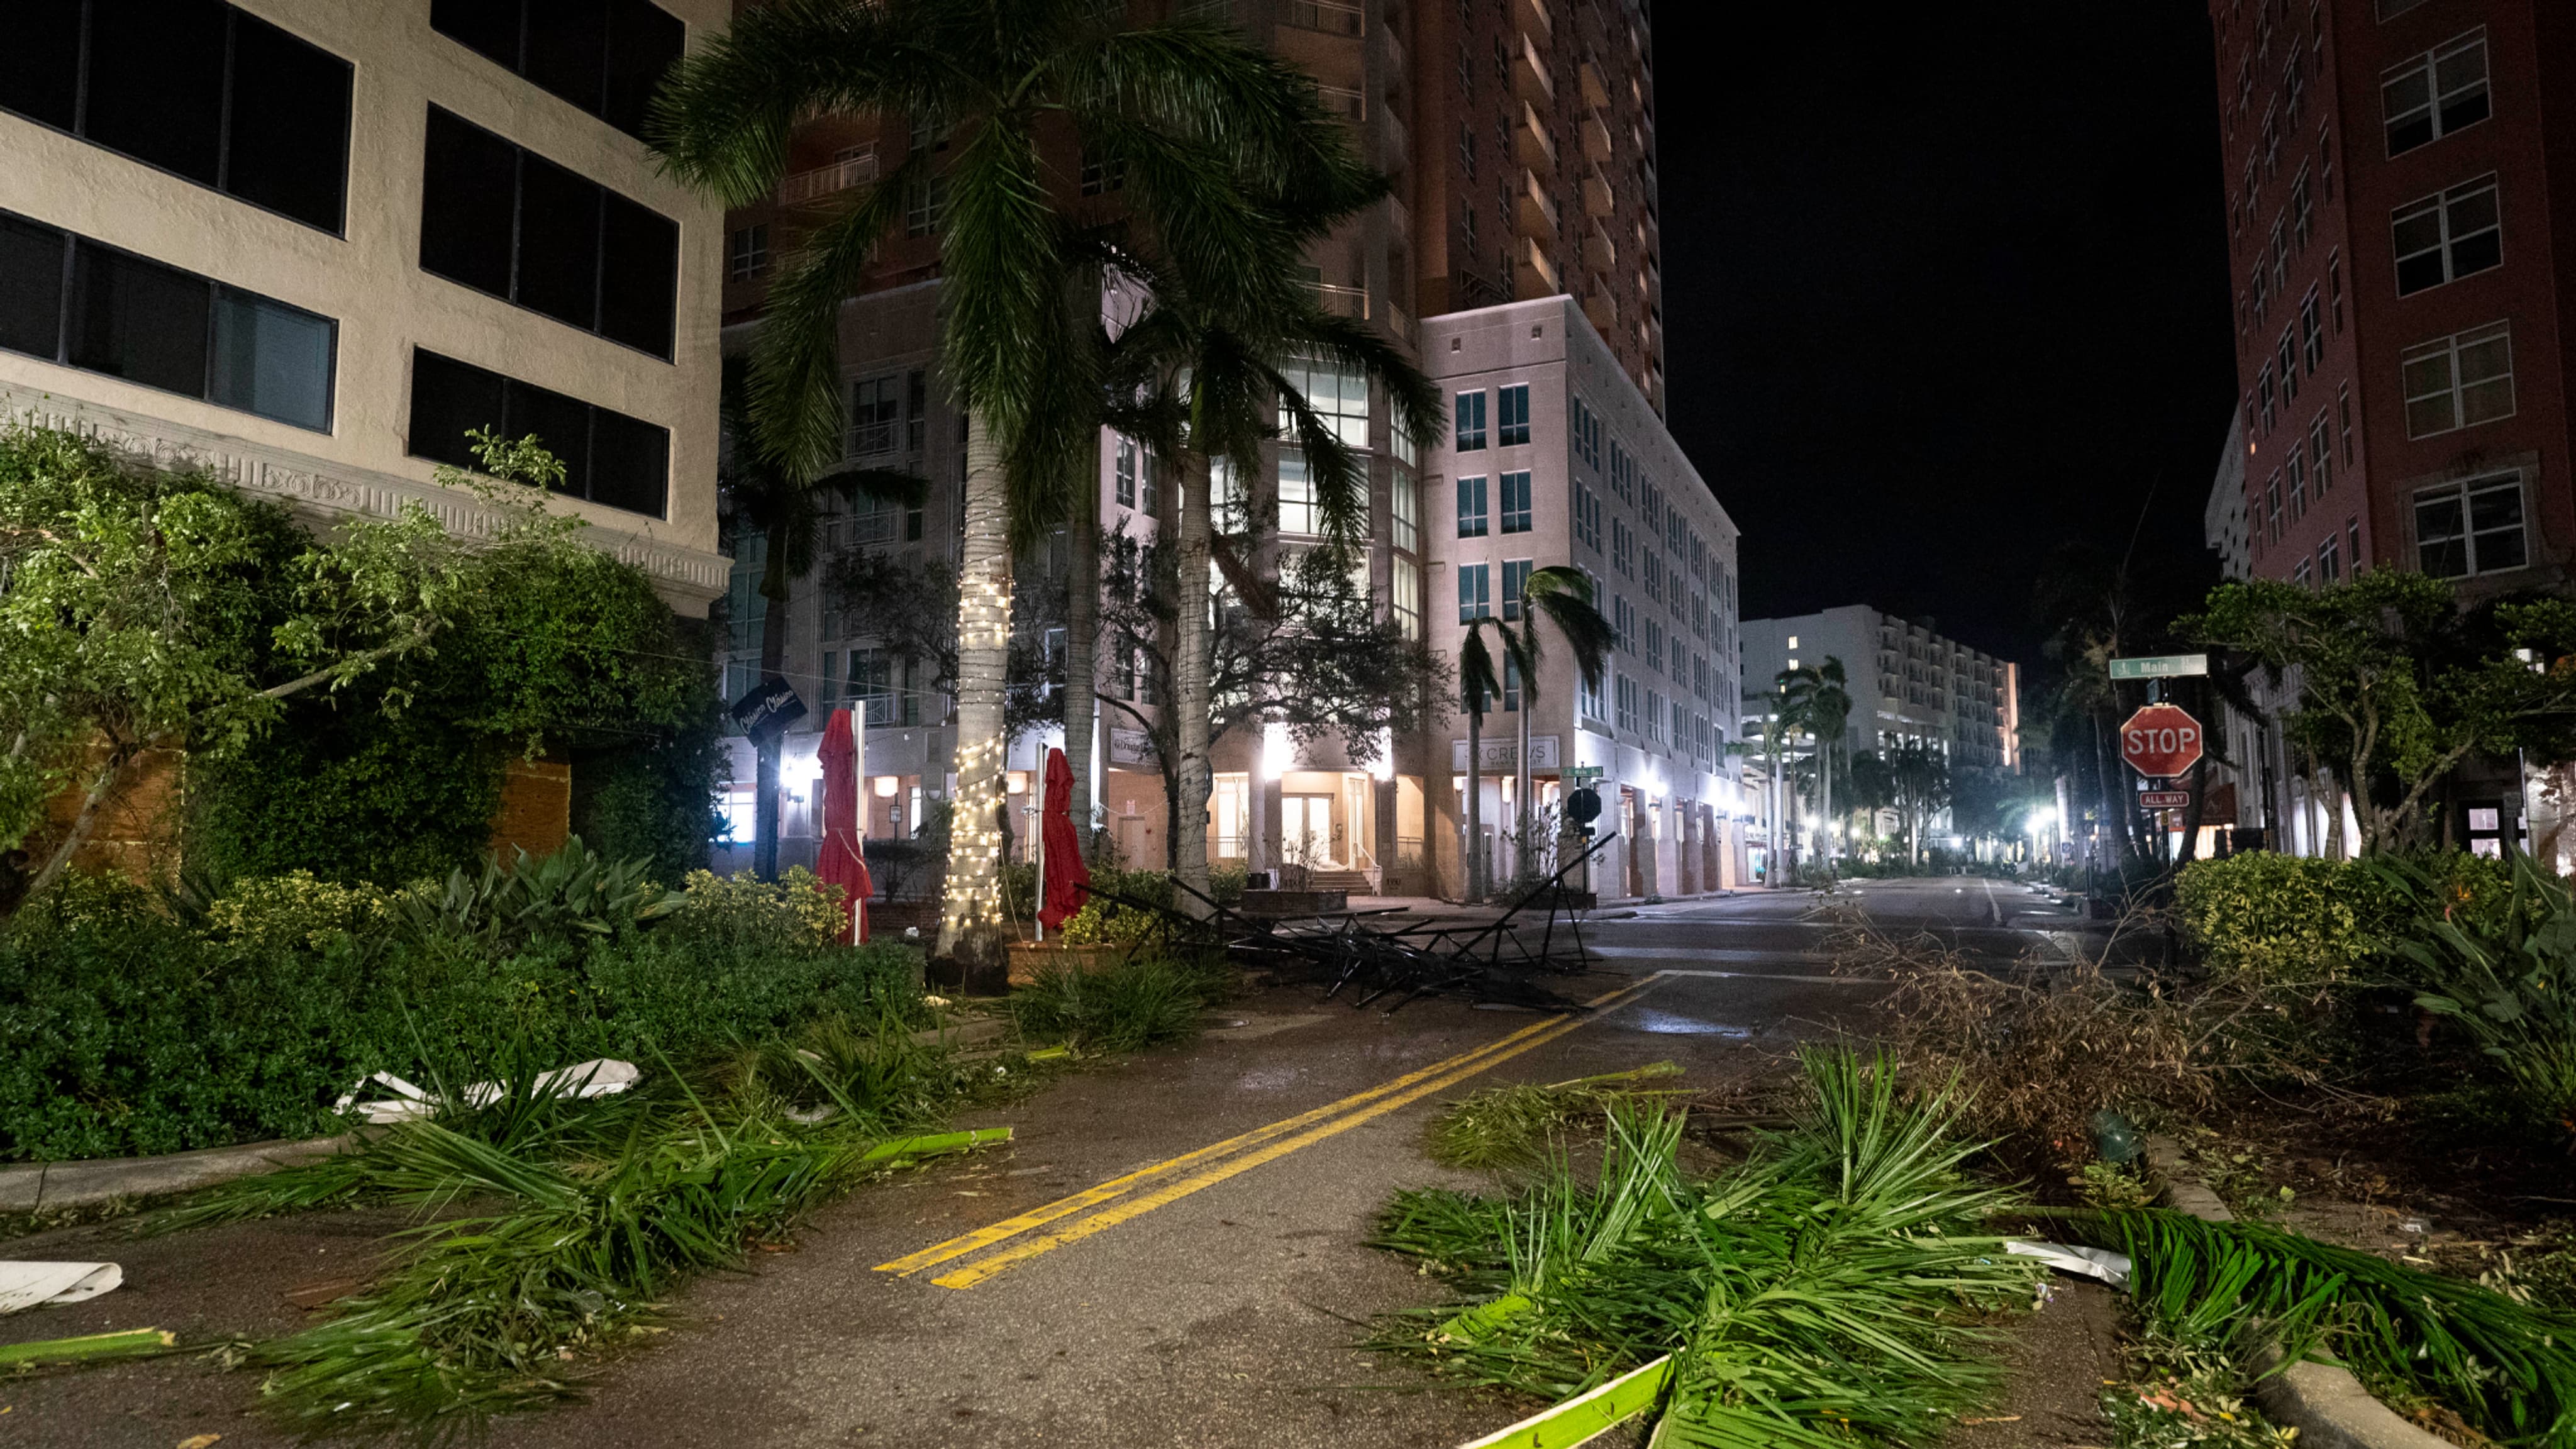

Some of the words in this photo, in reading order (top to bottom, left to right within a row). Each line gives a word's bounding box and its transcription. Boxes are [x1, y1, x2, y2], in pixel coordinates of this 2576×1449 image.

[2141, 662, 2169, 674] Main
[2128, 727, 2196, 755] STOP
[2145, 795, 2162, 804] ALL
[2165, 794, 2184, 804] WAY
